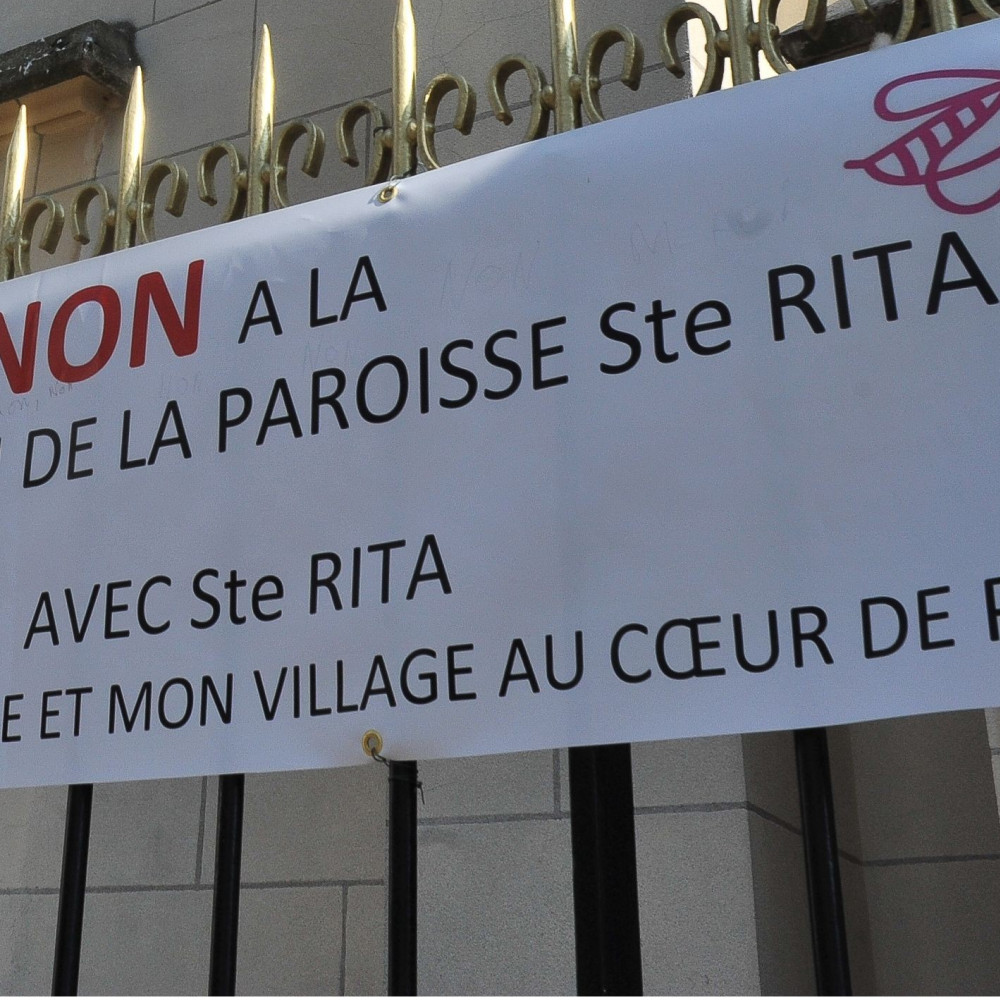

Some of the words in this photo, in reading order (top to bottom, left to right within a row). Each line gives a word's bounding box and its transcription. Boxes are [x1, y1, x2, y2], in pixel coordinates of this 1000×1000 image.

[22, 416, 98, 489] DE
[119, 399, 192, 471] LA
[218, 316, 569, 454] PAROISSE
[599, 299, 732, 375] Ste
[767, 231, 1000, 342] RITA
[237, 280, 283, 344] A
[309, 256, 388, 328] LA
[23, 575, 172, 650] AVEC
[190, 567, 284, 630] Ste
[309, 533, 453, 615] RITA
[39, 686, 93, 740] ET
[108, 672, 234, 735] MON
[253, 643, 477, 721] VILLAGE
[498, 630, 584, 698] AU
[610, 605, 834, 684] CŒUR
[860, 585, 956, 660] DE
